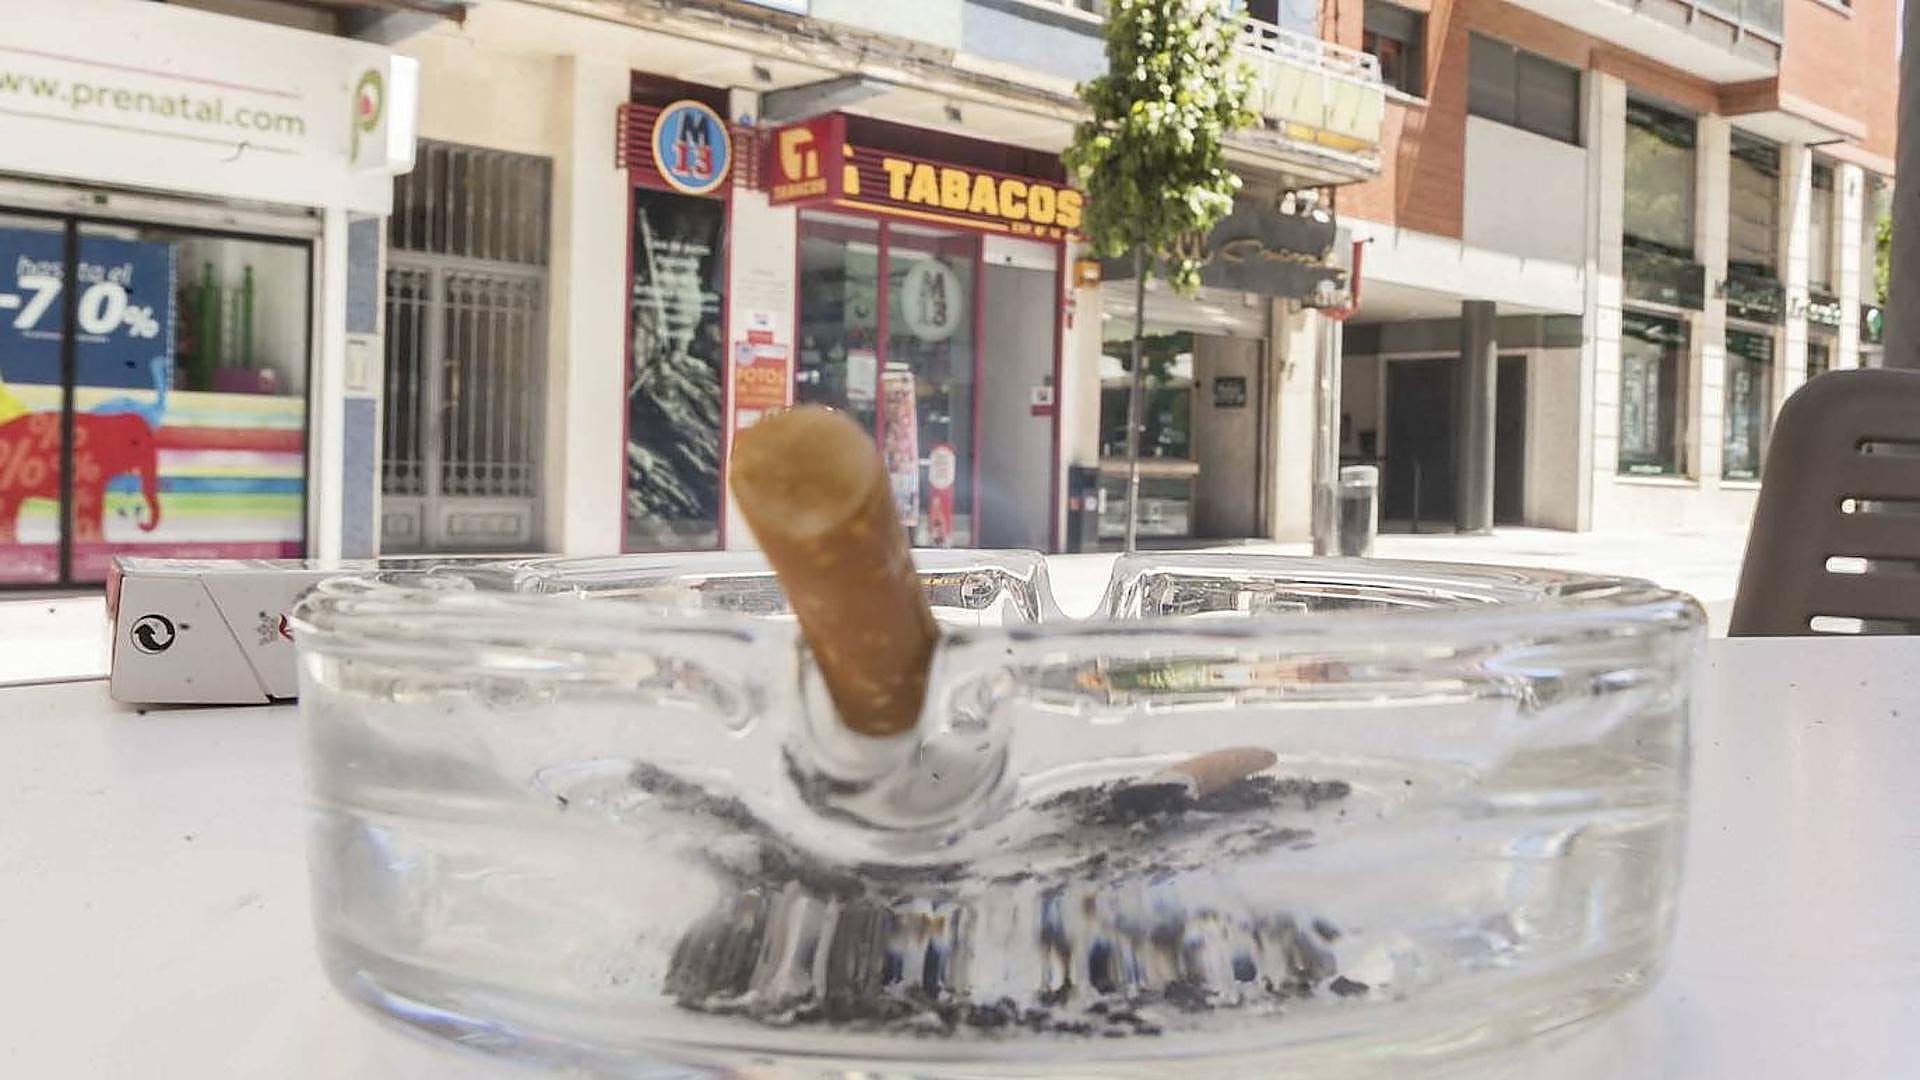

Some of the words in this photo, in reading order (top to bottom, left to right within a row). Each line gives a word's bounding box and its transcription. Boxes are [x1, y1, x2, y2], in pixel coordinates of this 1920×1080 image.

[676, 110, 710, 147] M
[671, 143, 714, 179] 13
[882, 157, 1083, 229] TABACOS
